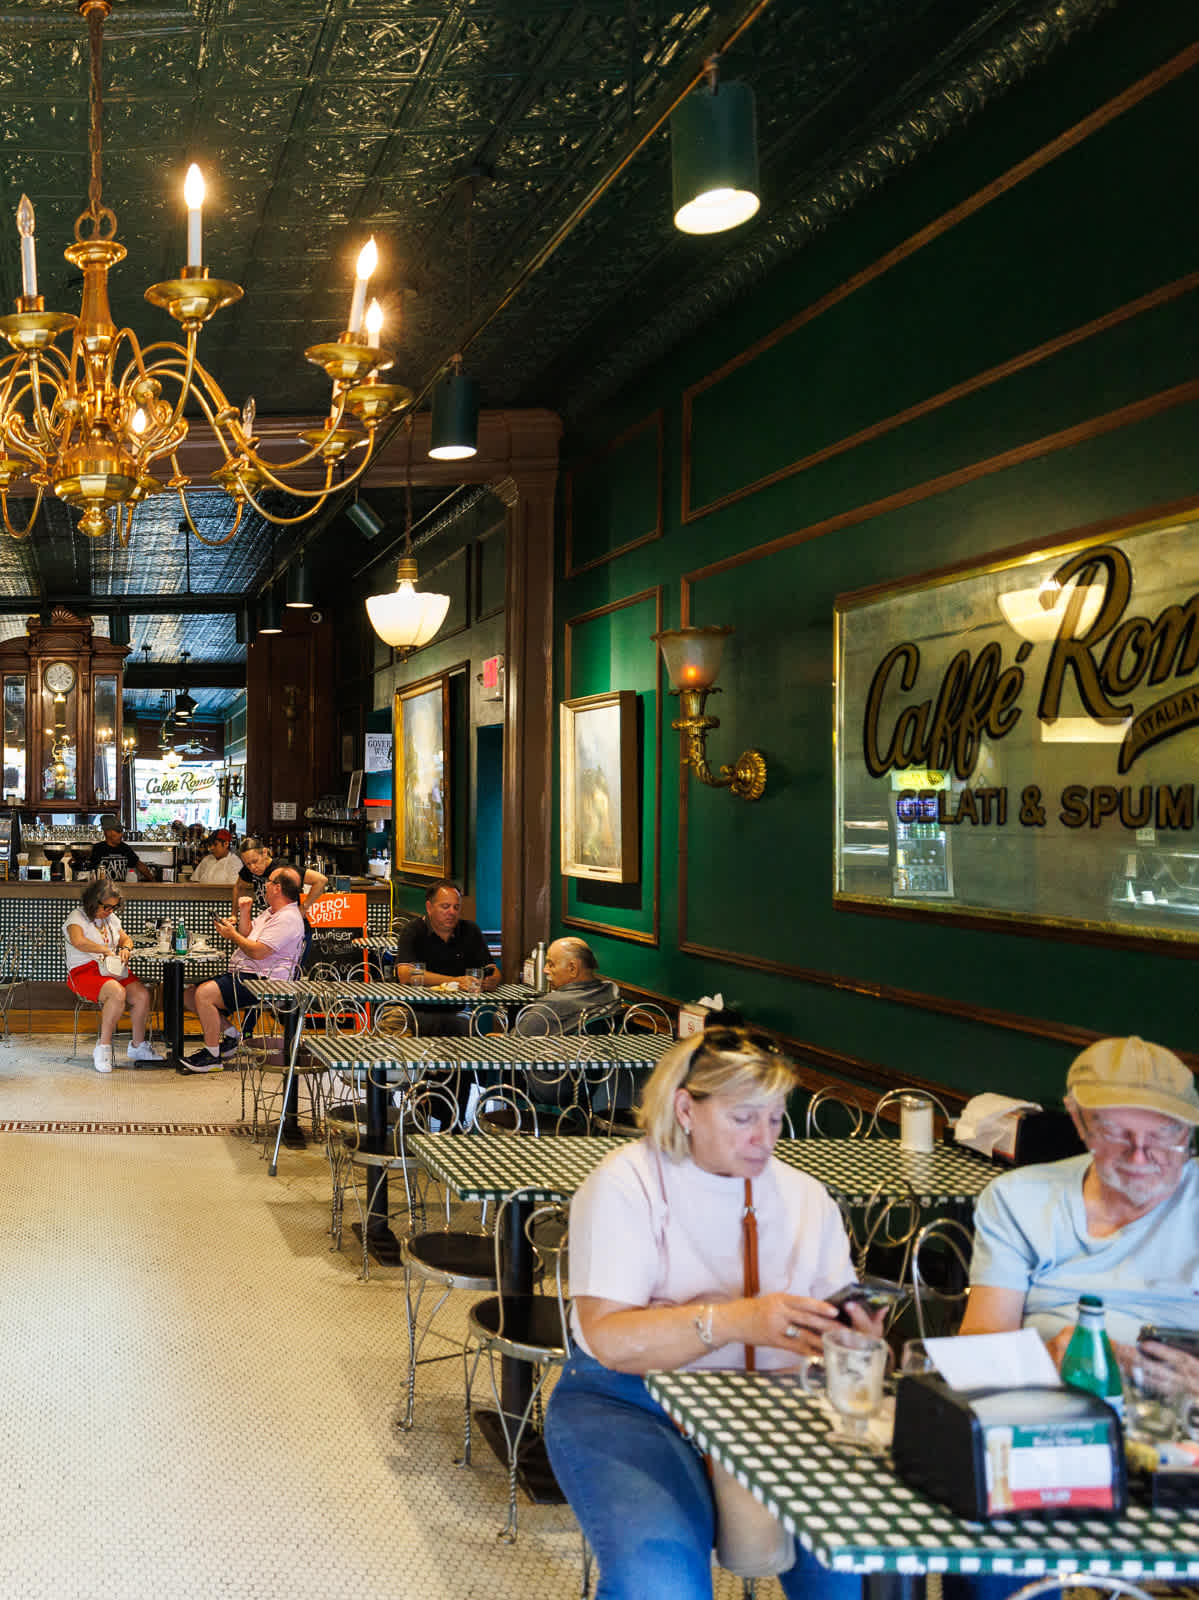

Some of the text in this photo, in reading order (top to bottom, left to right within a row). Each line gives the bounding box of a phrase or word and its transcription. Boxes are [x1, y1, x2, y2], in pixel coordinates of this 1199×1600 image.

[864, 642, 1034, 780] Caffé
[897, 784, 1199, 830] GELATI & SPUM
